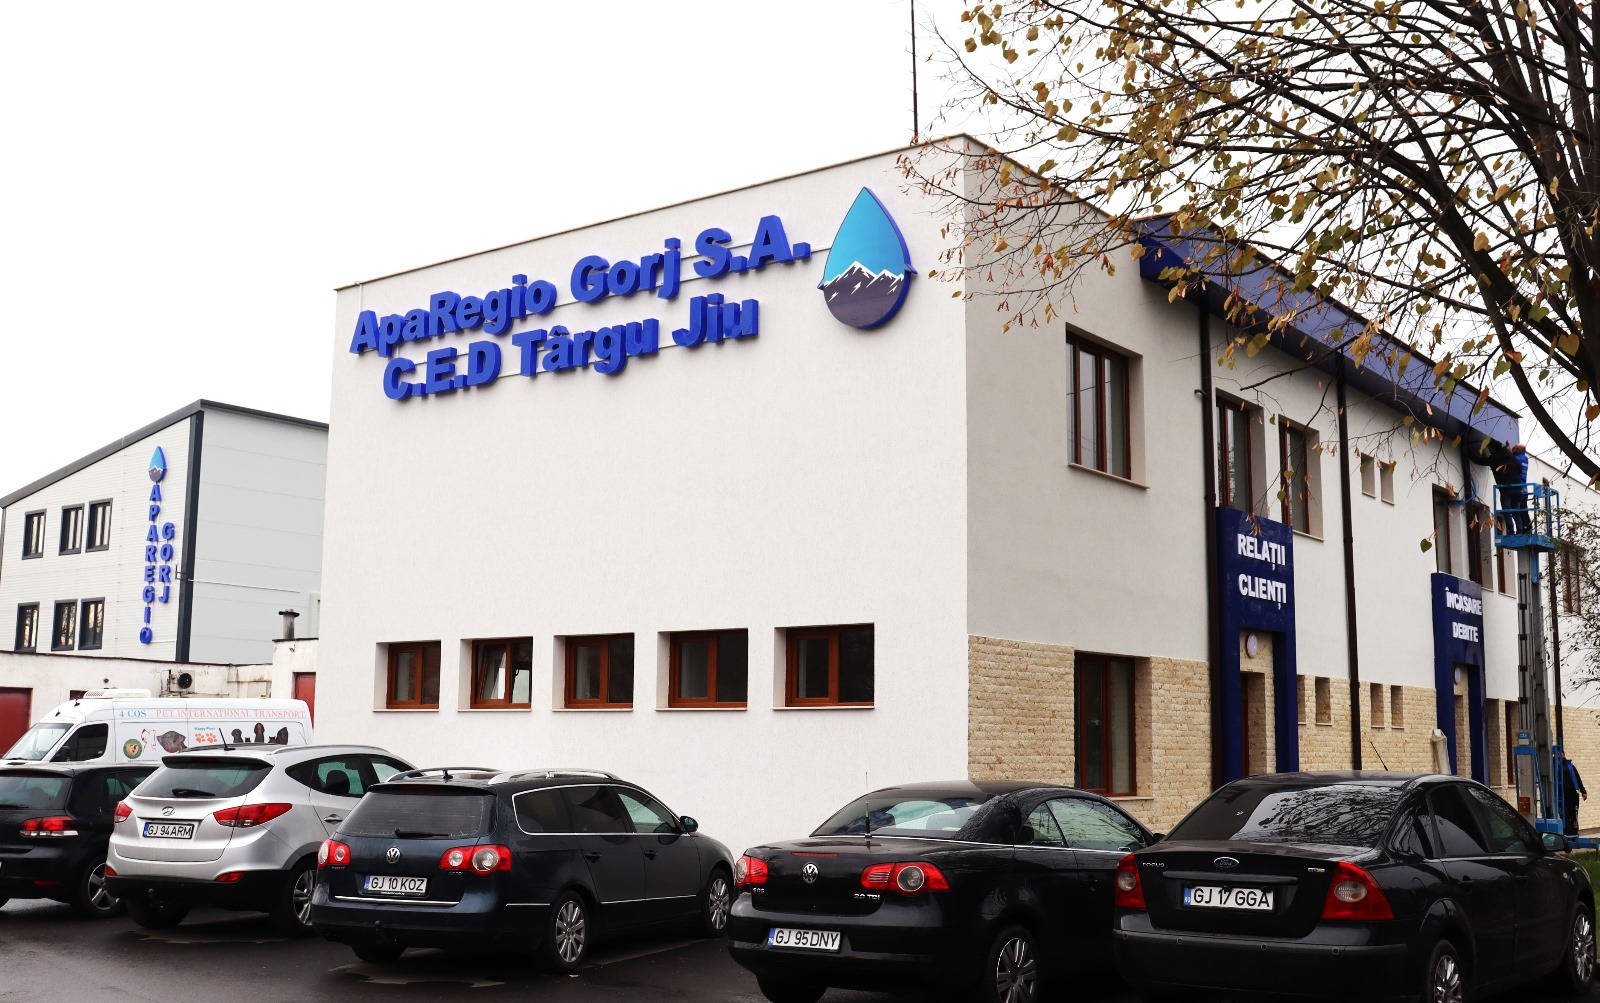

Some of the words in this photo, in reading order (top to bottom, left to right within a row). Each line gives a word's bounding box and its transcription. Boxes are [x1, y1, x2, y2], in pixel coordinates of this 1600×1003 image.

[349, 273, 558, 358] ApaRegio
[570, 237, 681, 303] Gorj
[693, 214, 812, 279] S.A.
[383, 346, 502, 400] C.E.D
[512, 317, 659, 377] Târgu
[671, 292, 759, 347] Jiu
[139, 484, 162, 644] APAREGIO
[158, 522, 175, 604] GORJ
[1237, 533, 1286, 571] RELAȚII
[1238, 573, 1287, 610] CLIENȚI
[1444, 586, 1483, 616] ÎNCASARE
[1452, 621, 1479, 643] DEBITE
[156, 710, 174, 718] PET
[177, 709, 250, 718] INTERNATIONAL
[254, 710, 305, 719] TRANSPORT
[148, 825, 159, 836] GJ
[370, 877, 386, 891] GJ
[1193, 888, 1213, 905] GJ
[1235, 890, 1271, 908] GGA
[775, 929, 792, 945] GJ
